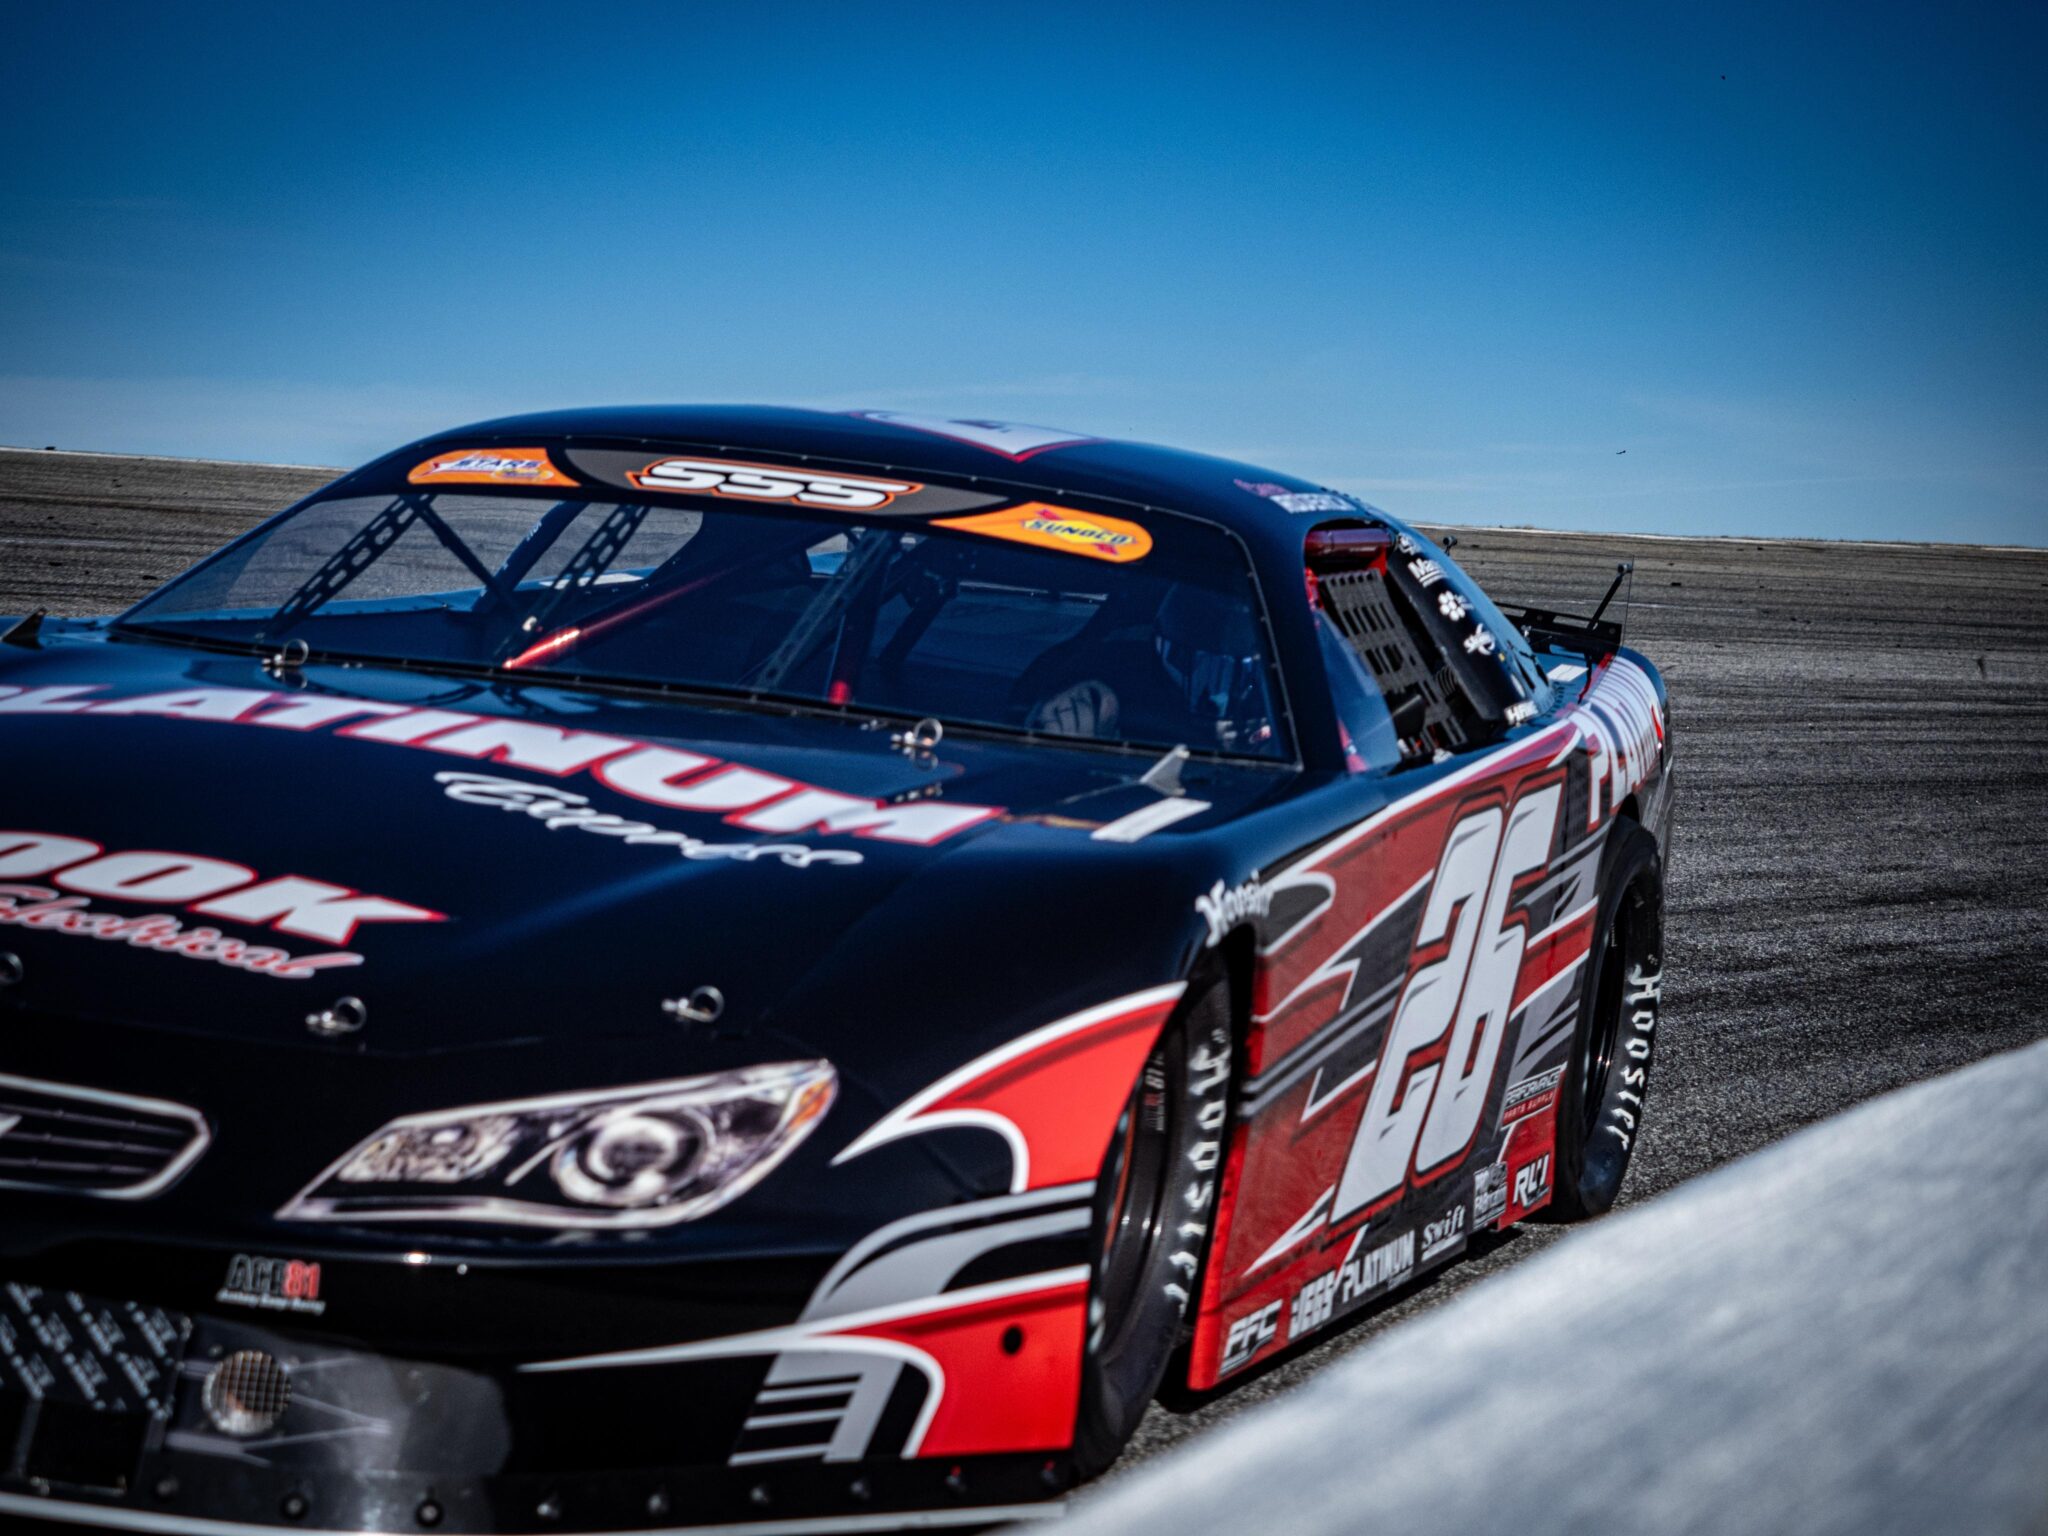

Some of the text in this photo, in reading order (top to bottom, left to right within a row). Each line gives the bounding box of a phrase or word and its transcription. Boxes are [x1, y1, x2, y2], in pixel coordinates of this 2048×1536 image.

[636, 459, 911, 508] SSS
[1030, 518, 1130, 545] SUNOCO
[1328, 778, 1564, 1227] 26
[1422, 1204, 1466, 1249] Swift
